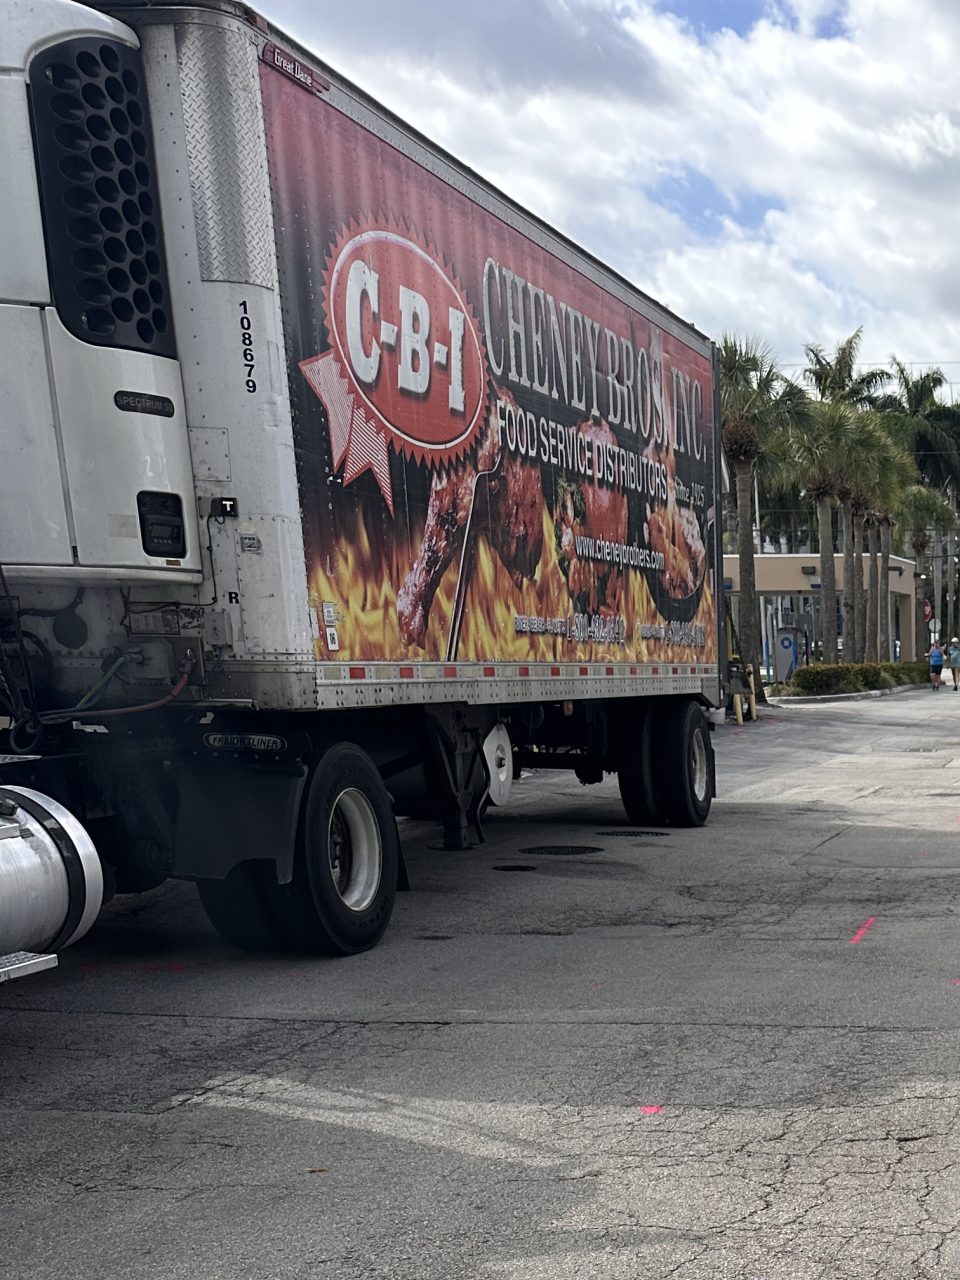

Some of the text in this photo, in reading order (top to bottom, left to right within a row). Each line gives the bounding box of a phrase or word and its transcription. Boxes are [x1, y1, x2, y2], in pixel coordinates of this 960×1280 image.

[274, 48, 312, 87] Great Dane
[239, 300, 257, 394] 108679
[345, 259, 465, 412] C-B-I
[483, 257, 600, 417] CHENEY
[115, 395, 163, 410] SPECTRUM
[496, 399, 667, 500] FOOD SERVICE DISTRIBUTORS
[222, 500, 234, 512] T
[575, 534, 665, 570] www.cheneybrothers.com
[228, 591, 240, 605] R
